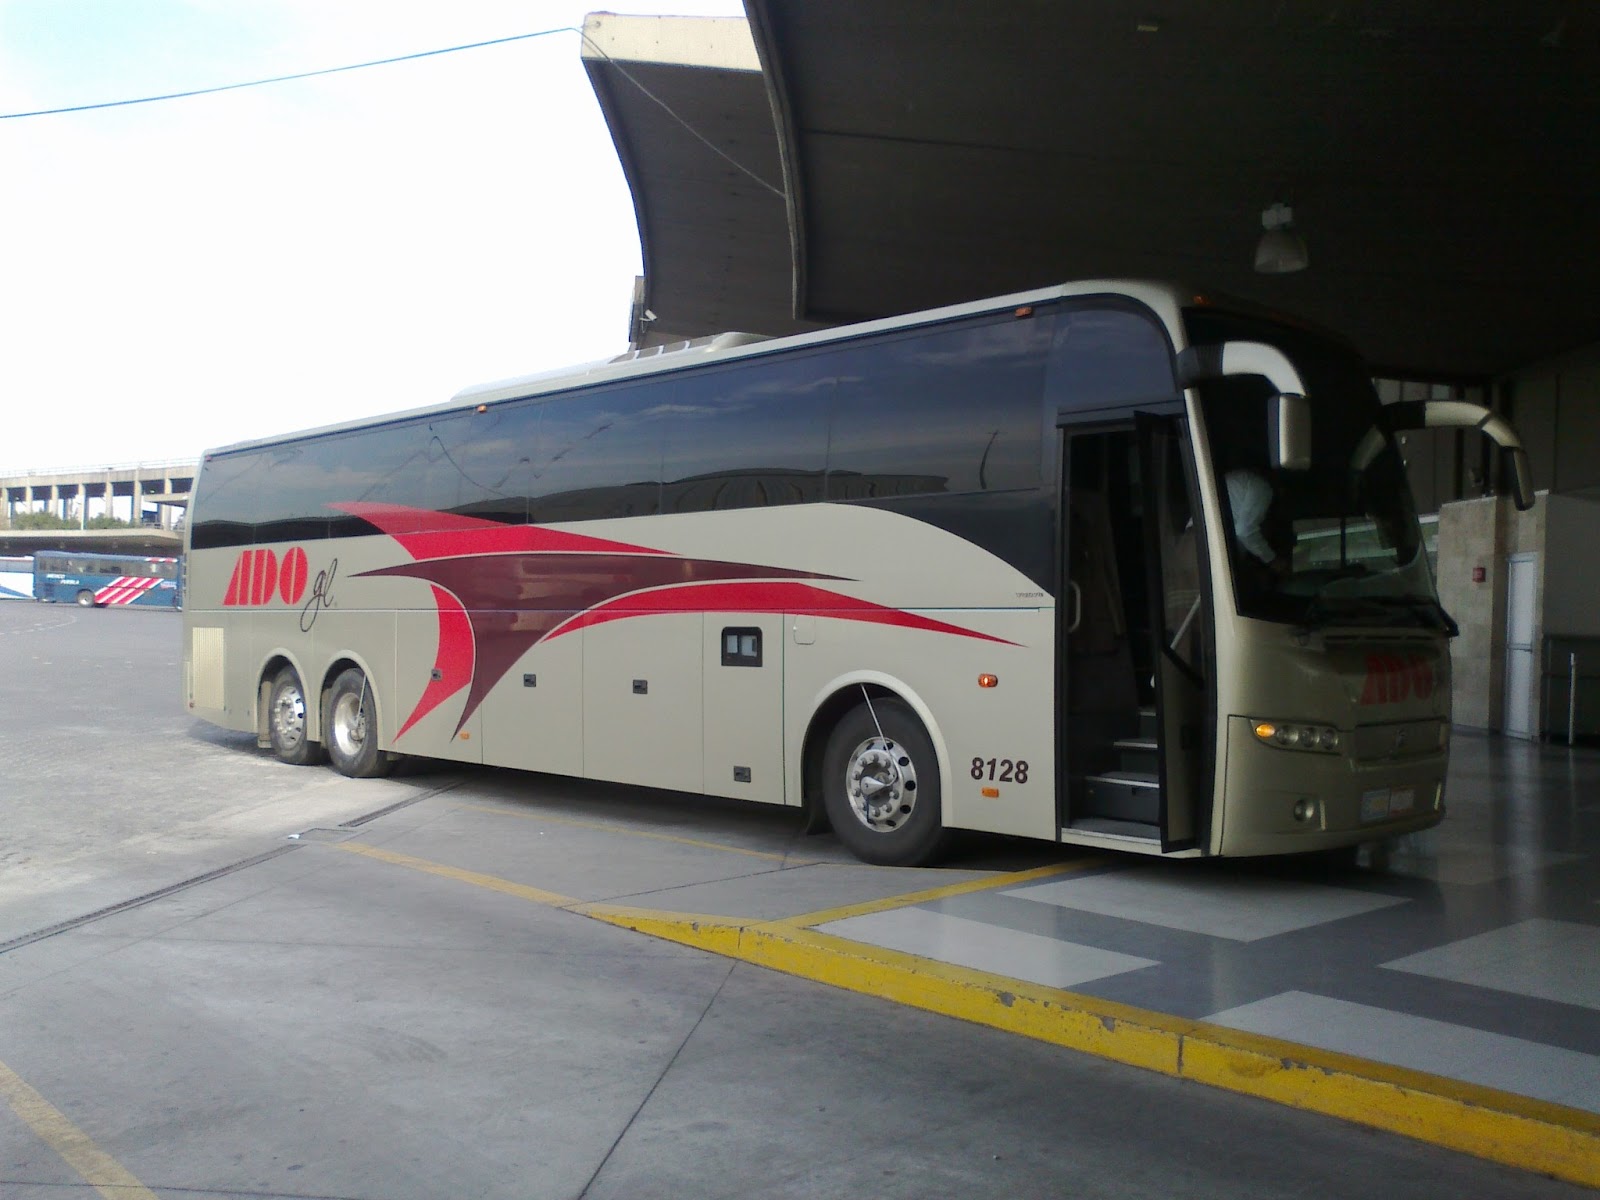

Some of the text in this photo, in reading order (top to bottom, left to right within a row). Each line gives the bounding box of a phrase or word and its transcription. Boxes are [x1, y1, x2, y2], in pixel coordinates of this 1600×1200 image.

[223, 547, 308, 605] ADO
[1360, 655, 1434, 705] ADO
[970, 757, 1029, 784] 8128
